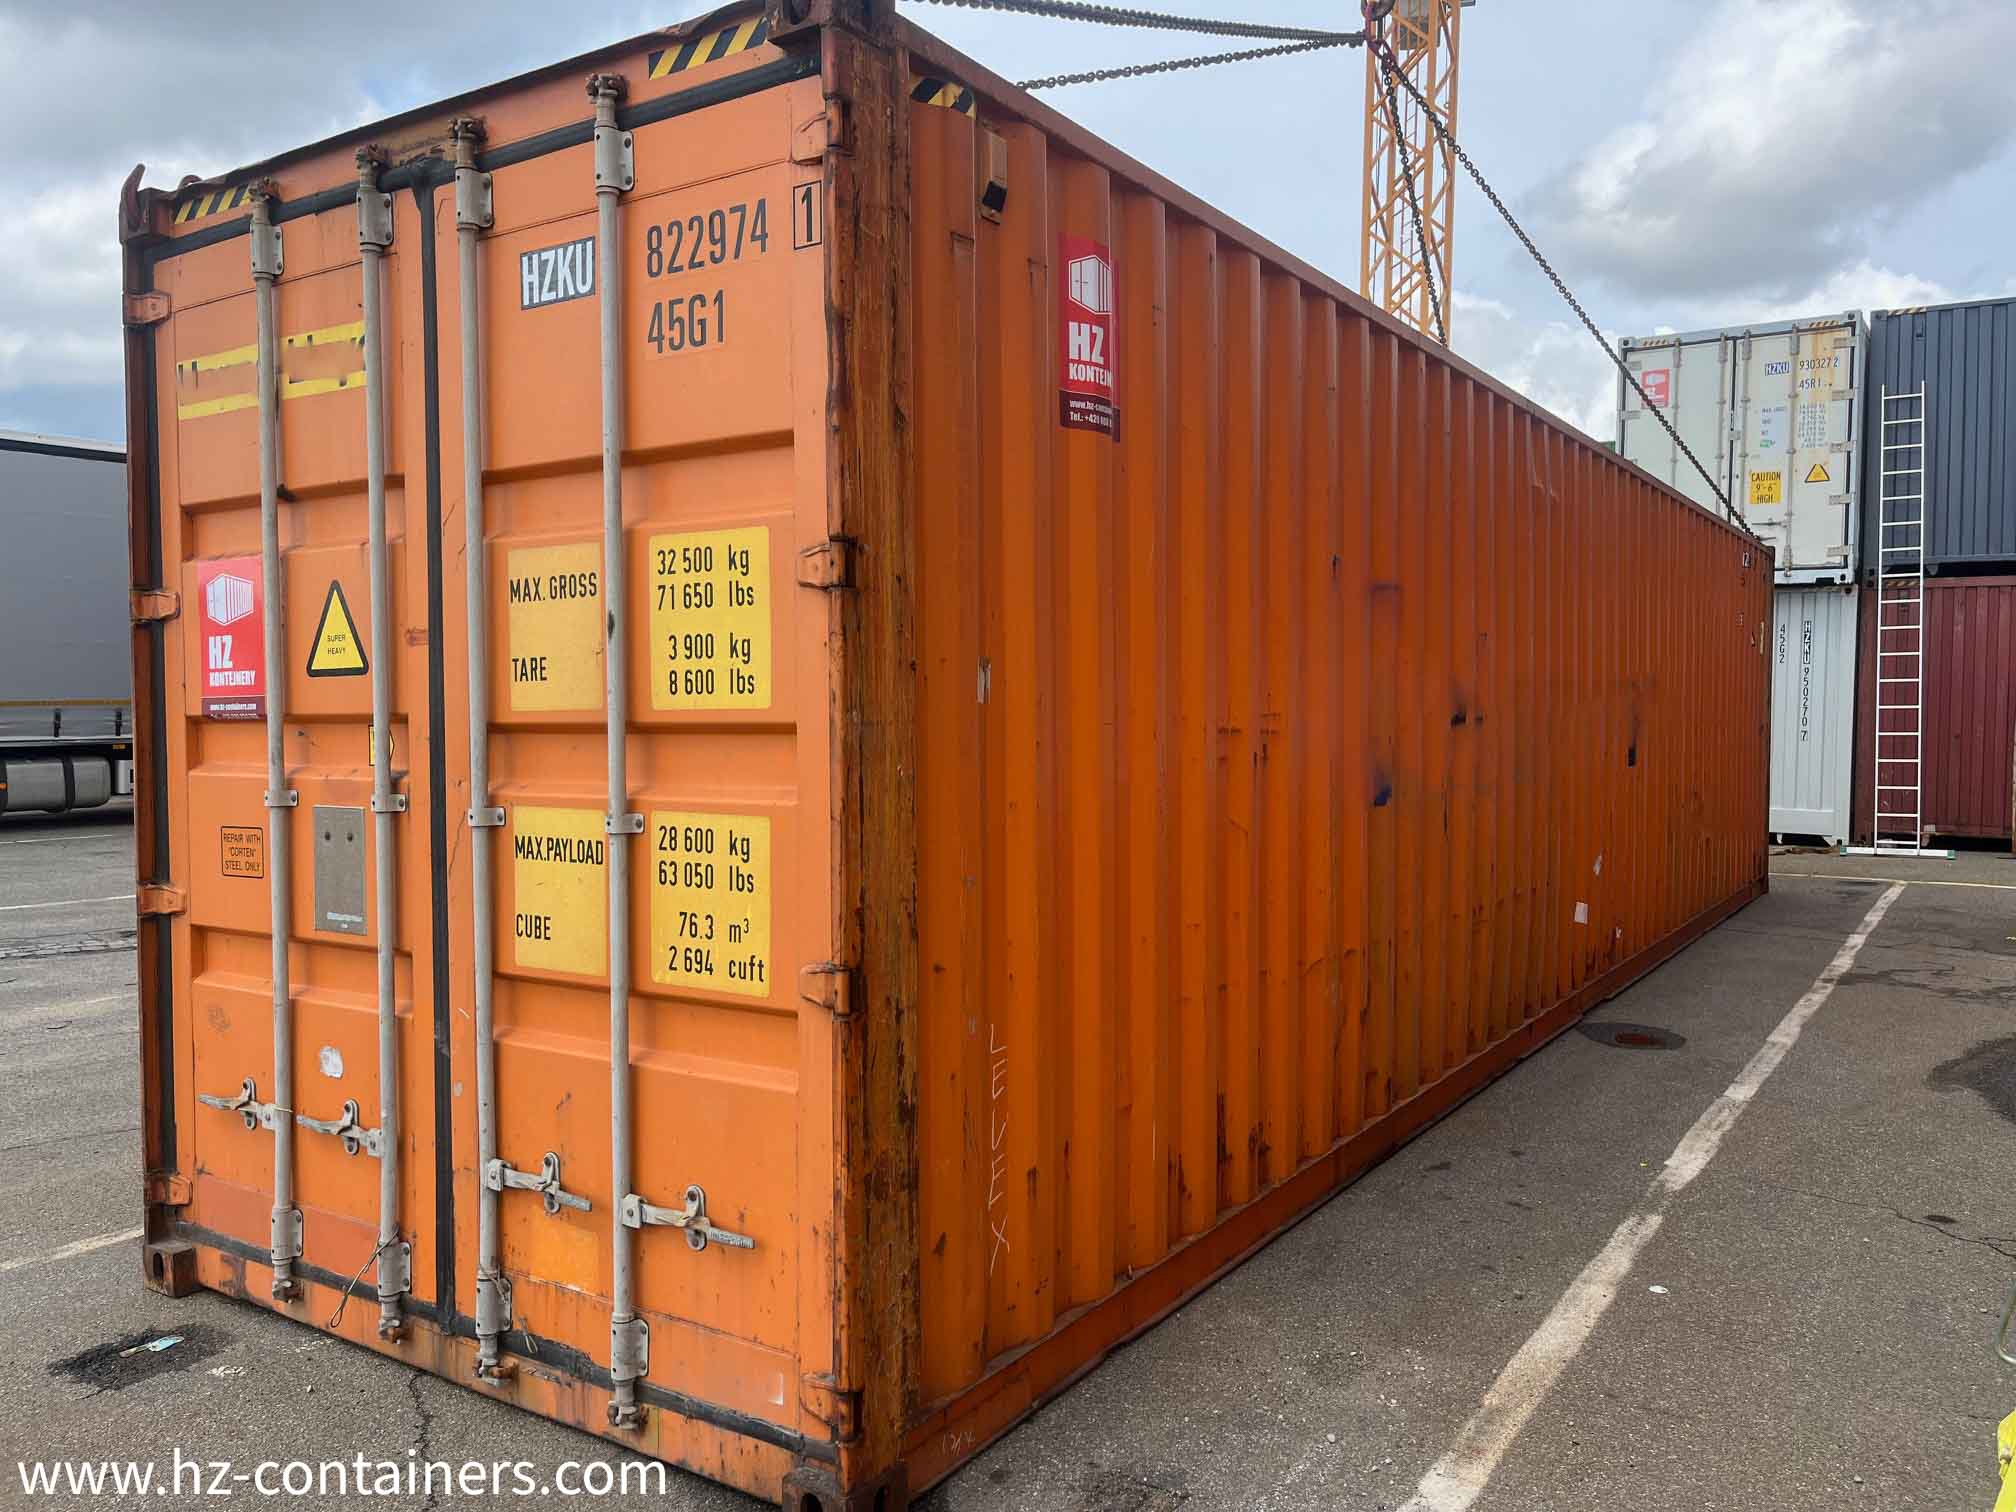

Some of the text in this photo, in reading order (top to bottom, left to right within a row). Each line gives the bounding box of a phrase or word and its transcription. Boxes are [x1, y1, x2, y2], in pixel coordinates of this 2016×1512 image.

[647, 198, 768, 278] 822974
[520, 237, 594, 307] HZKU
[647, 289, 725, 354] 45G1
[1069, 321, 1105, 365] HZ
[1764, 361, 1790, 376] HZKU
[1751, 472, 1781, 482] CAUTION
[1757, 495, 1774, 505] HIGH
[657, 544, 750, 576] 32 500 kg
[510, 572, 598, 603] MAX. GROSS
[657, 581, 754, 610] 71 650 lbs
[208, 635, 233, 669] HZ
[327, 634, 346, 642] SUPER
[327, 647, 346, 656] HEAVY
[668, 632, 751, 664] 3 900 kg
[512, 656, 548, 682] TARE
[669, 668, 755, 695] 8 600 lbs
[223, 833, 261, 844] REPAIR WITH
[658, 825, 750, 863] 28 600 kg
[225, 860, 261, 872] STEEL ONLY
[658, 860, 754, 893] 63 050 lbs
[515, 913, 552, 941] CUBE
[679, 911, 714, 940] 76.3
[668, 945, 765, 982] 2 694 cuft
